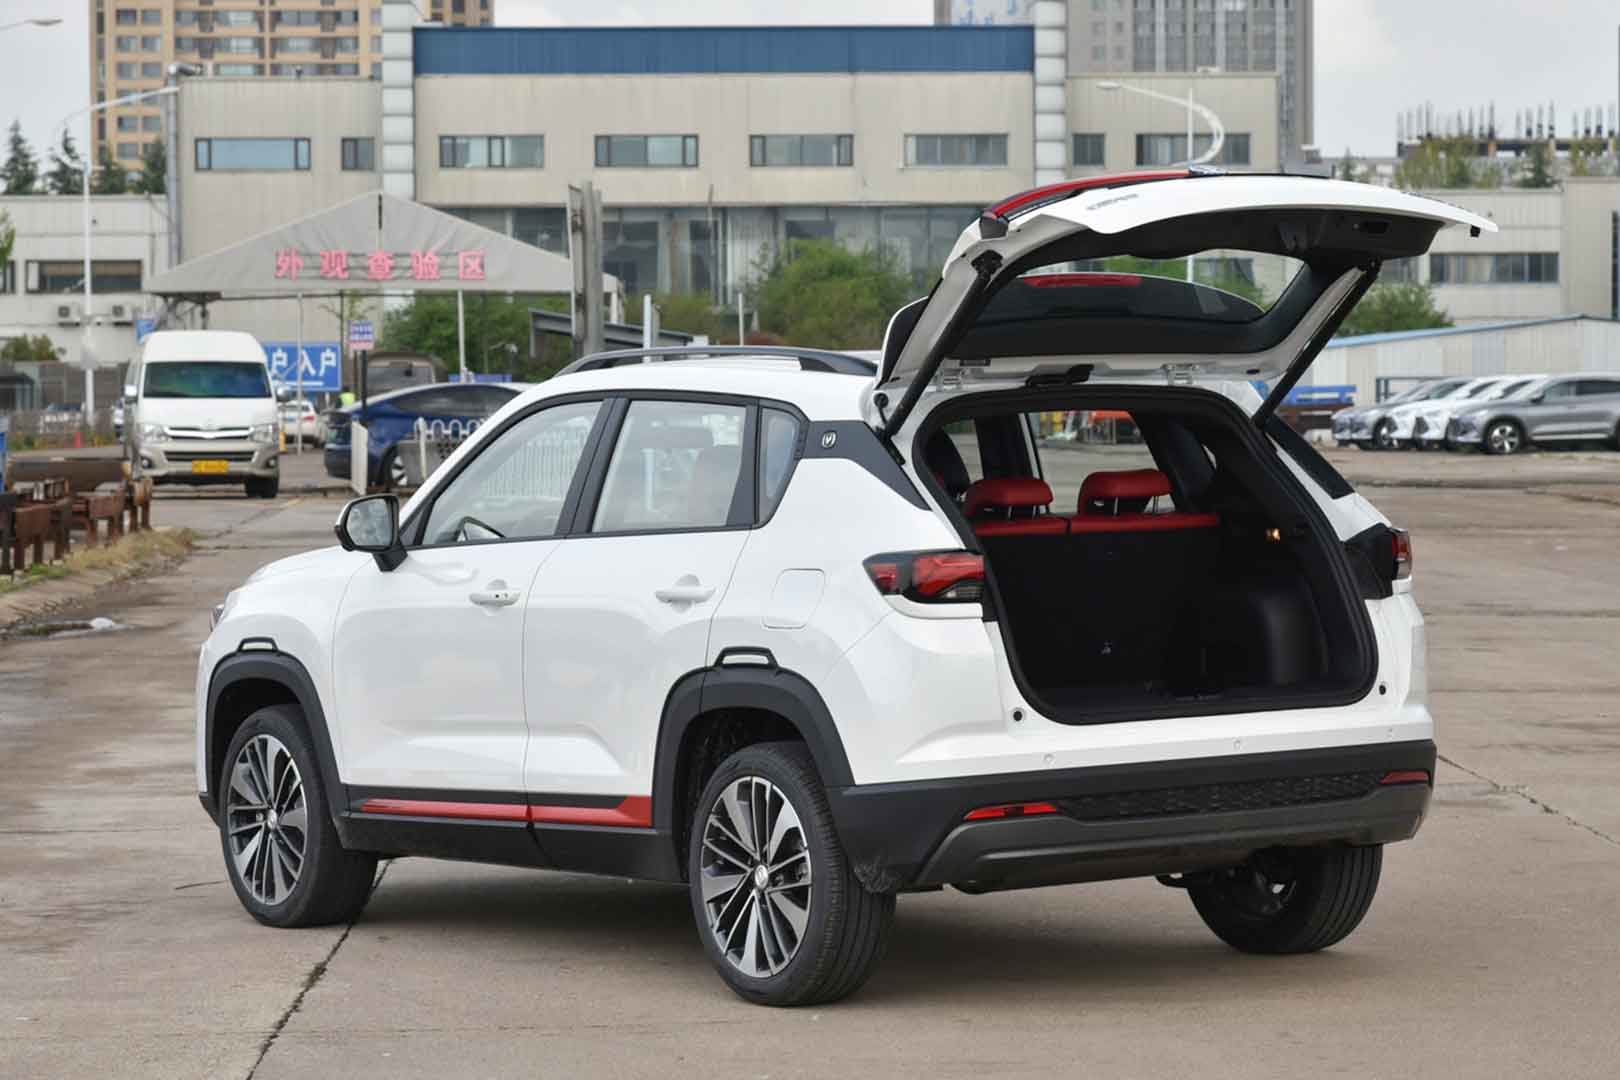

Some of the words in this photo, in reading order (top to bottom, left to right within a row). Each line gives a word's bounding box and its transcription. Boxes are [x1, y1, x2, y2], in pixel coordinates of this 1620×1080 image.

[274, 248, 486, 281] 外观查验区
